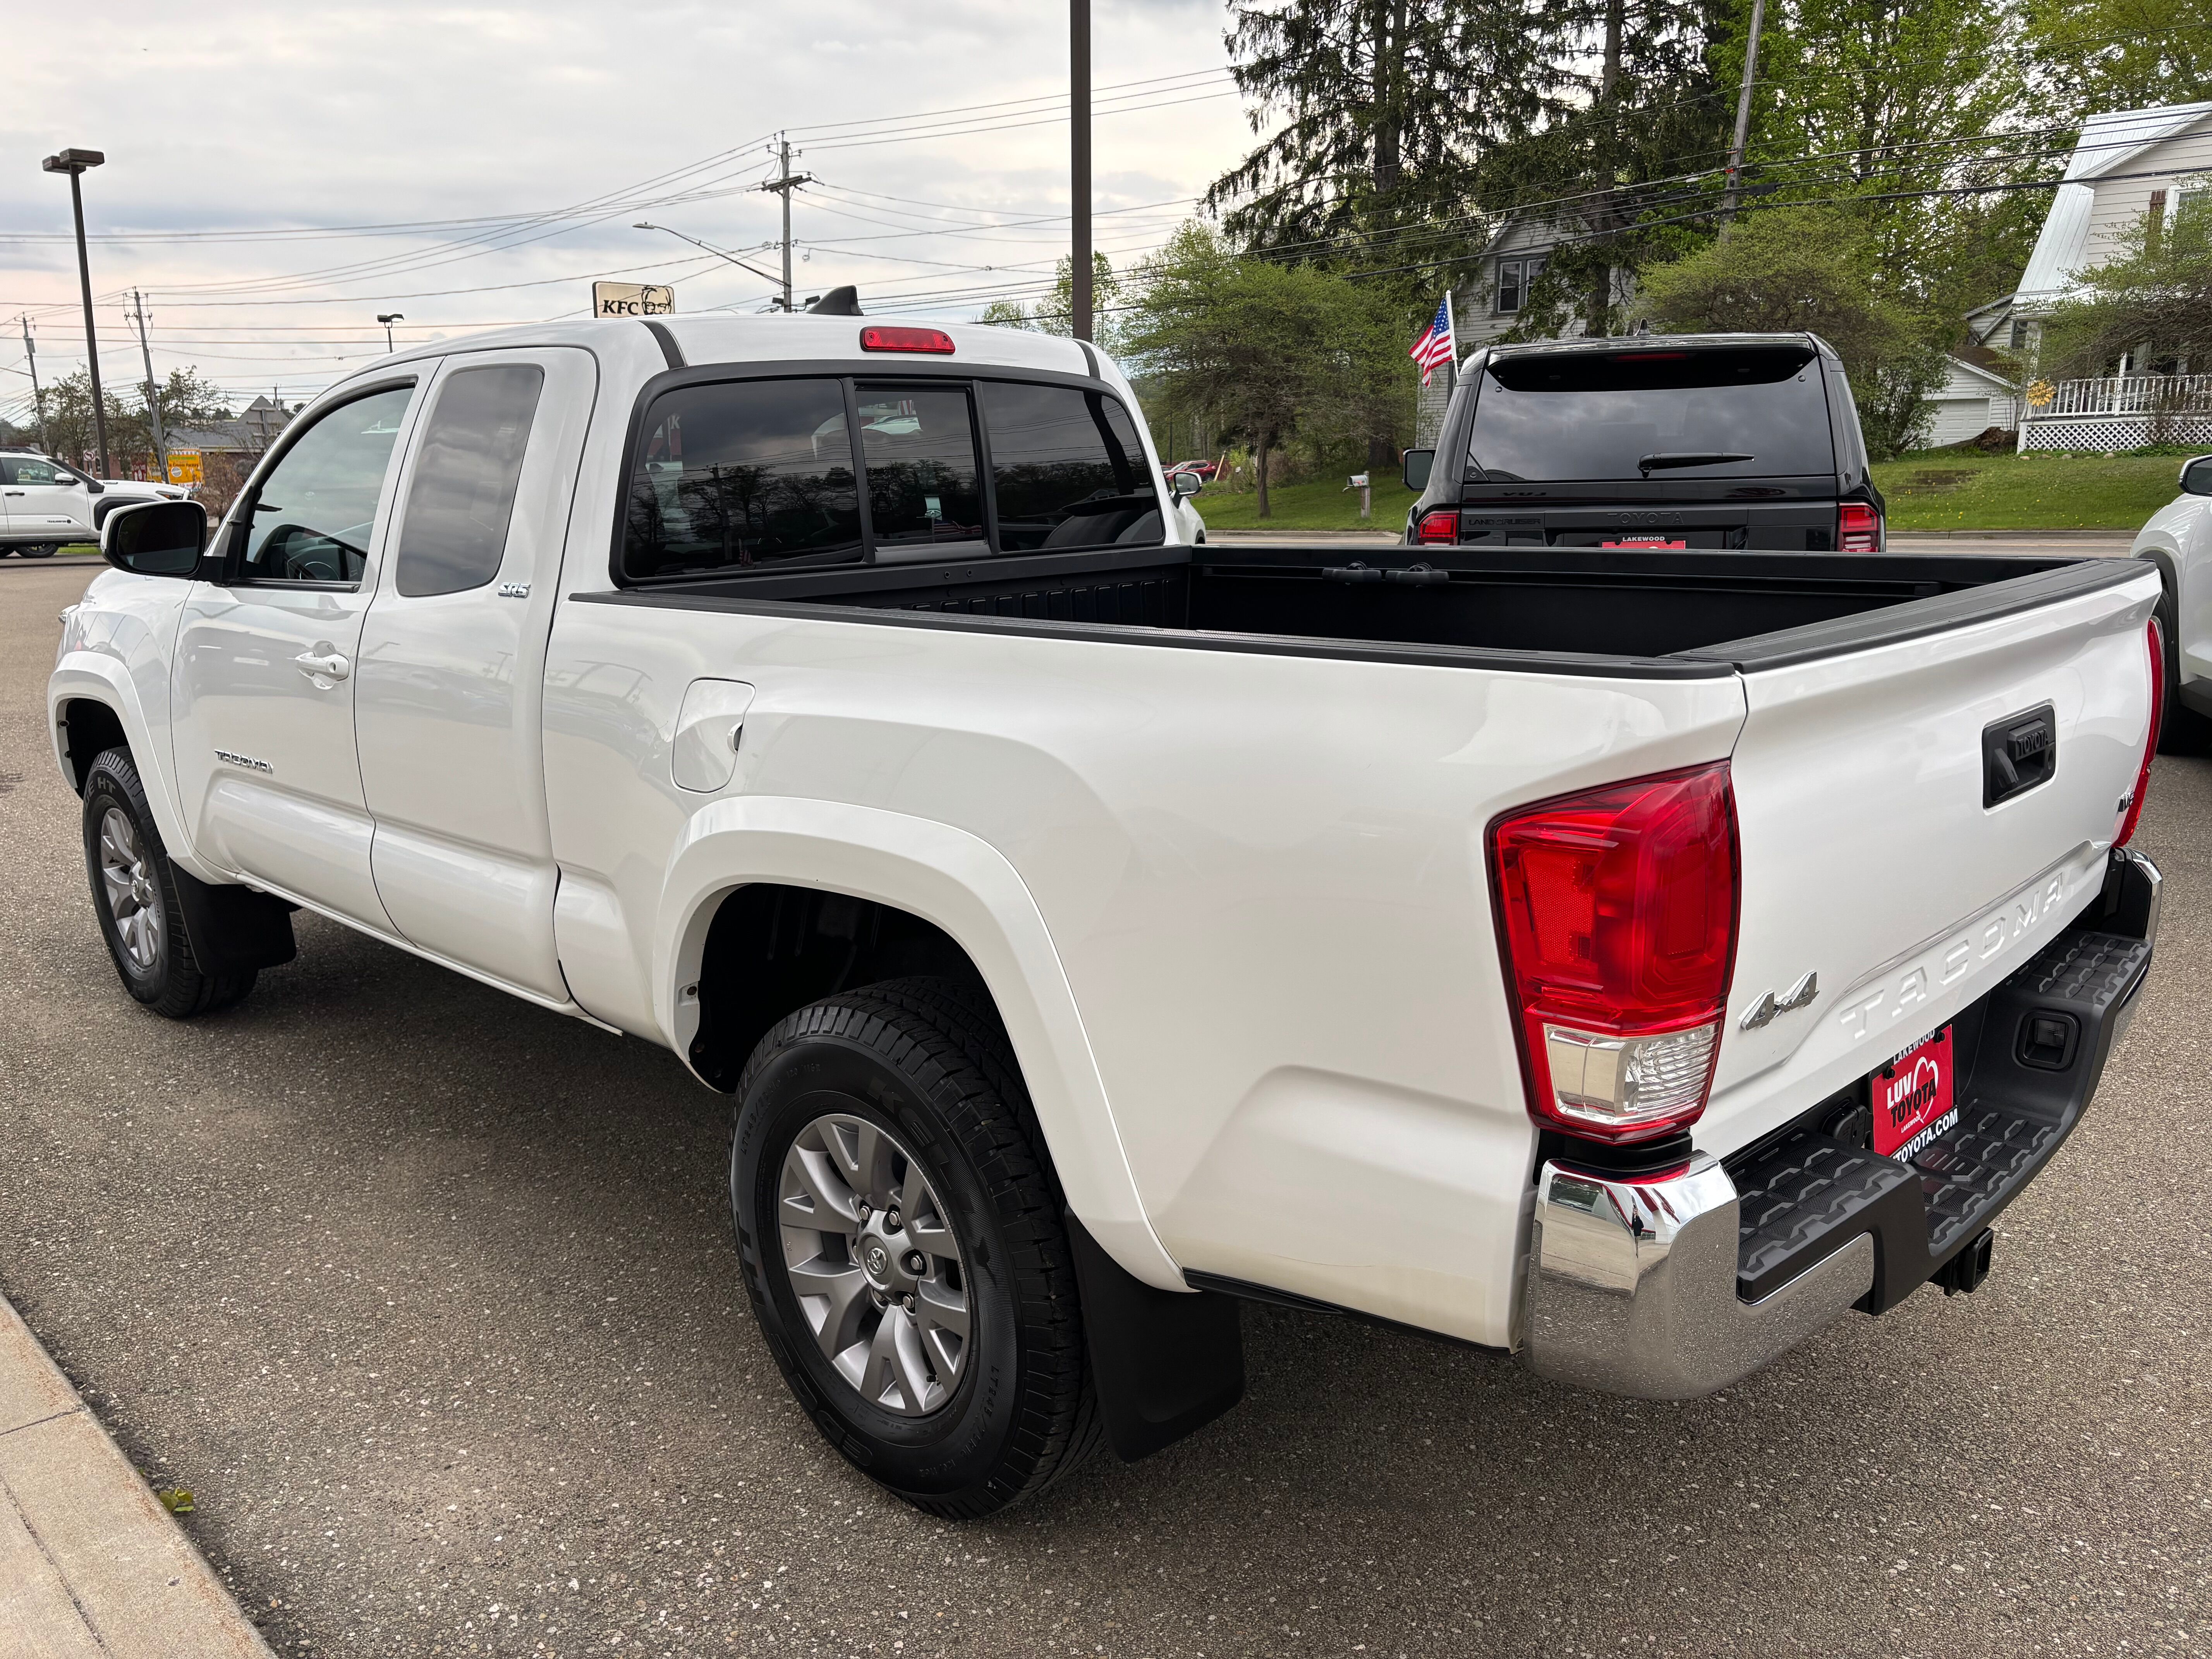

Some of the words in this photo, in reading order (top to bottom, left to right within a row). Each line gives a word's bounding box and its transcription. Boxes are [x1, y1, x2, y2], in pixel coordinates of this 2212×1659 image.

[602, 300, 639, 315] KFC
[1607, 512, 1684, 525] TOYOTA
[2017, 729, 2049, 756] TOYOTA
[214, 749, 274, 775] TACOMA
[1839, 872, 2063, 1039] TACOMA
[1893, 1029, 1935, 1065] LAKEWOOD
[1887, 1071, 1912, 1109] LUV
[1891, 1078, 1937, 1128] TOYOTA
[1893, 1108, 1958, 1163] TOYOTA.COM
[1901, 1114, 1921, 1133] LAKEWOOD
